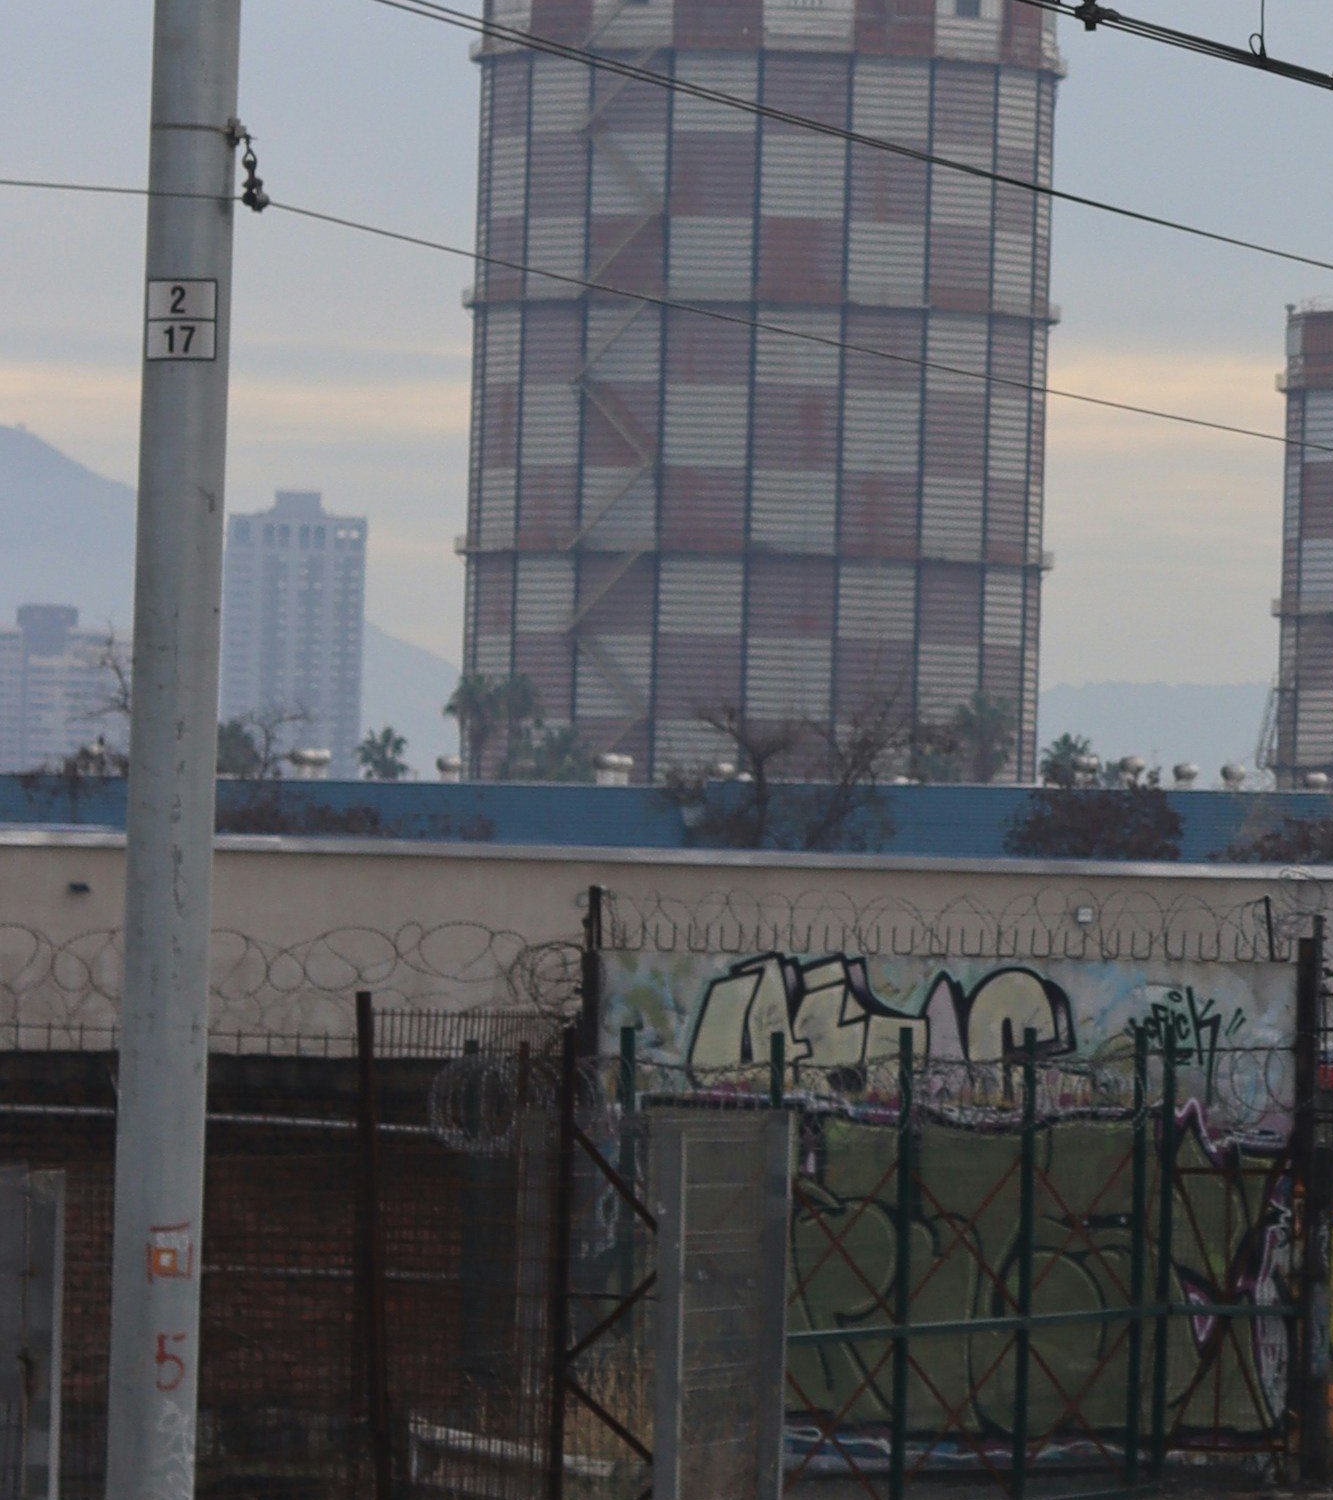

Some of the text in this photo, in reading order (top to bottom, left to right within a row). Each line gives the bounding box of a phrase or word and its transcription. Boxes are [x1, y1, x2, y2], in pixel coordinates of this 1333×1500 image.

[169, 284, 187, 315] 2
[163, 325, 197, 354] 17
[155, 1332, 188, 1393] 5
